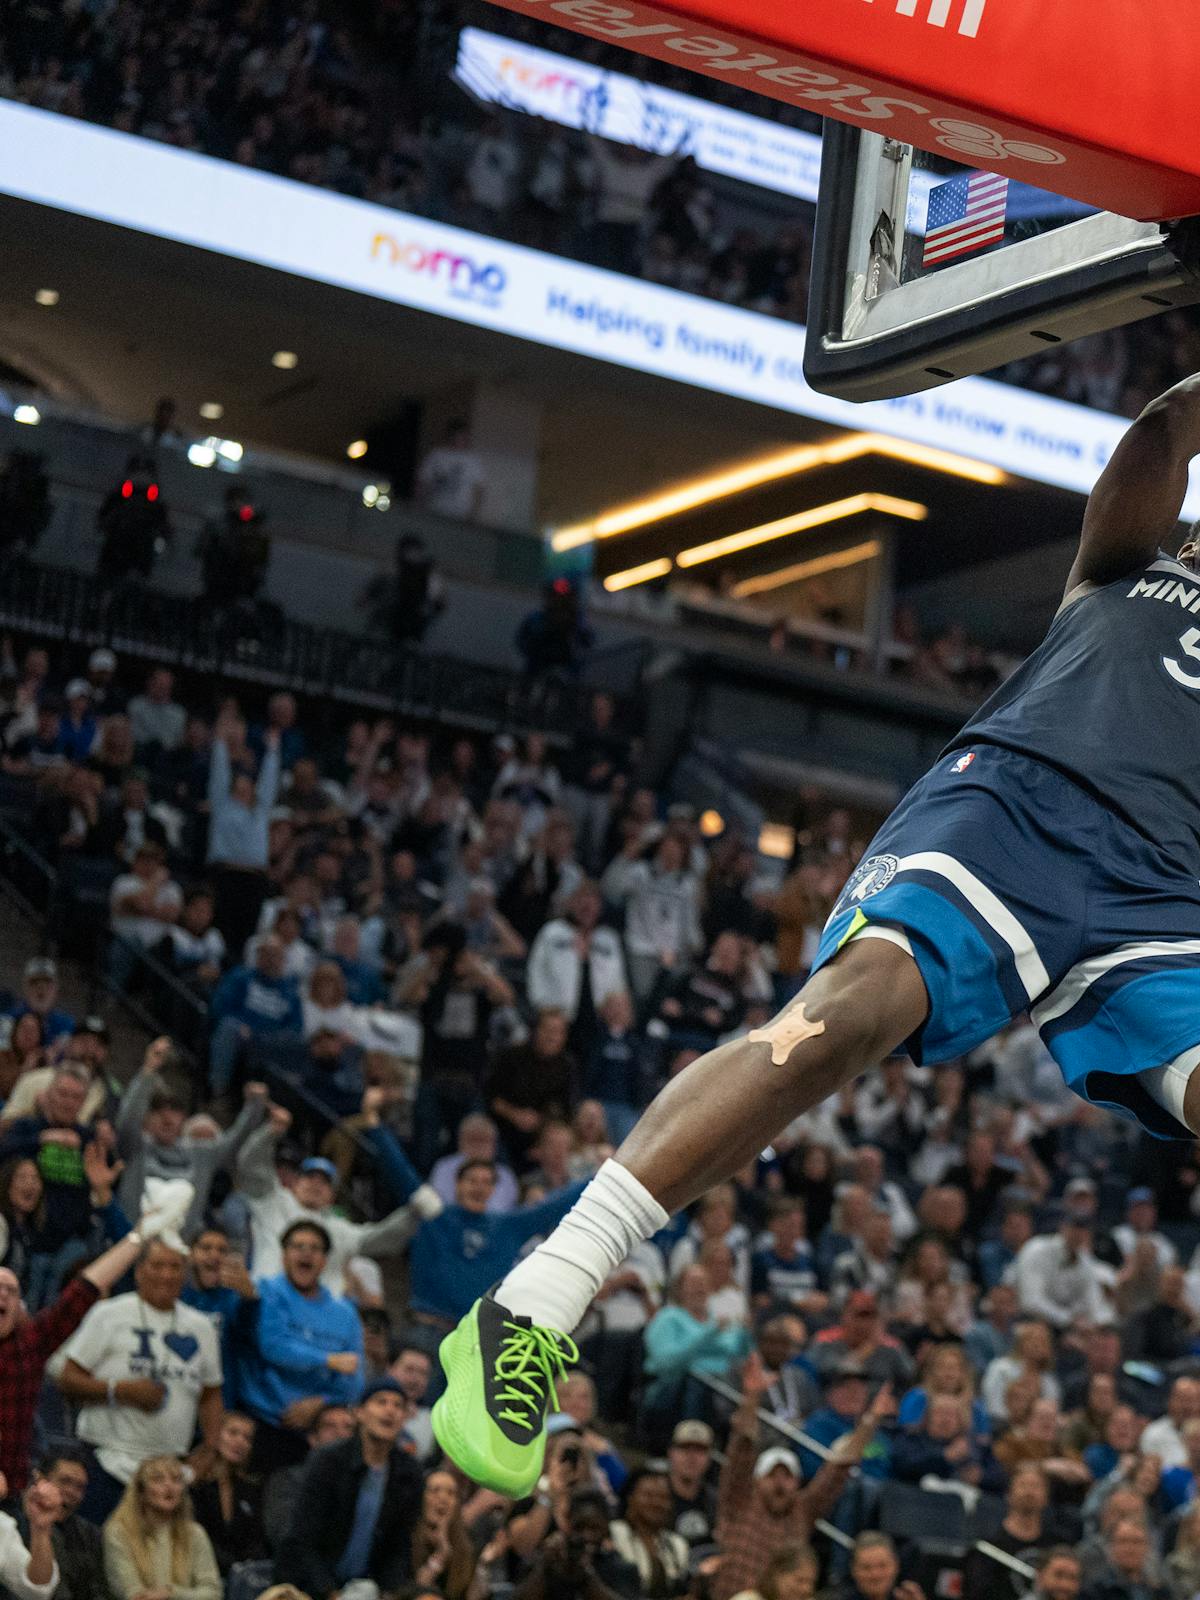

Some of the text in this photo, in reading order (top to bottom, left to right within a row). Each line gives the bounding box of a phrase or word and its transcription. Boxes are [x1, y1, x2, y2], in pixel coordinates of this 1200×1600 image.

[664, 36, 930, 120] State
[371, 233, 507, 293] nomo
[546, 289, 665, 349] Helping
[675, 323, 766, 374] family
[935, 397, 1005, 438] know
[1014, 427, 1084, 459] more
[131, 1328, 155, 1359] I
